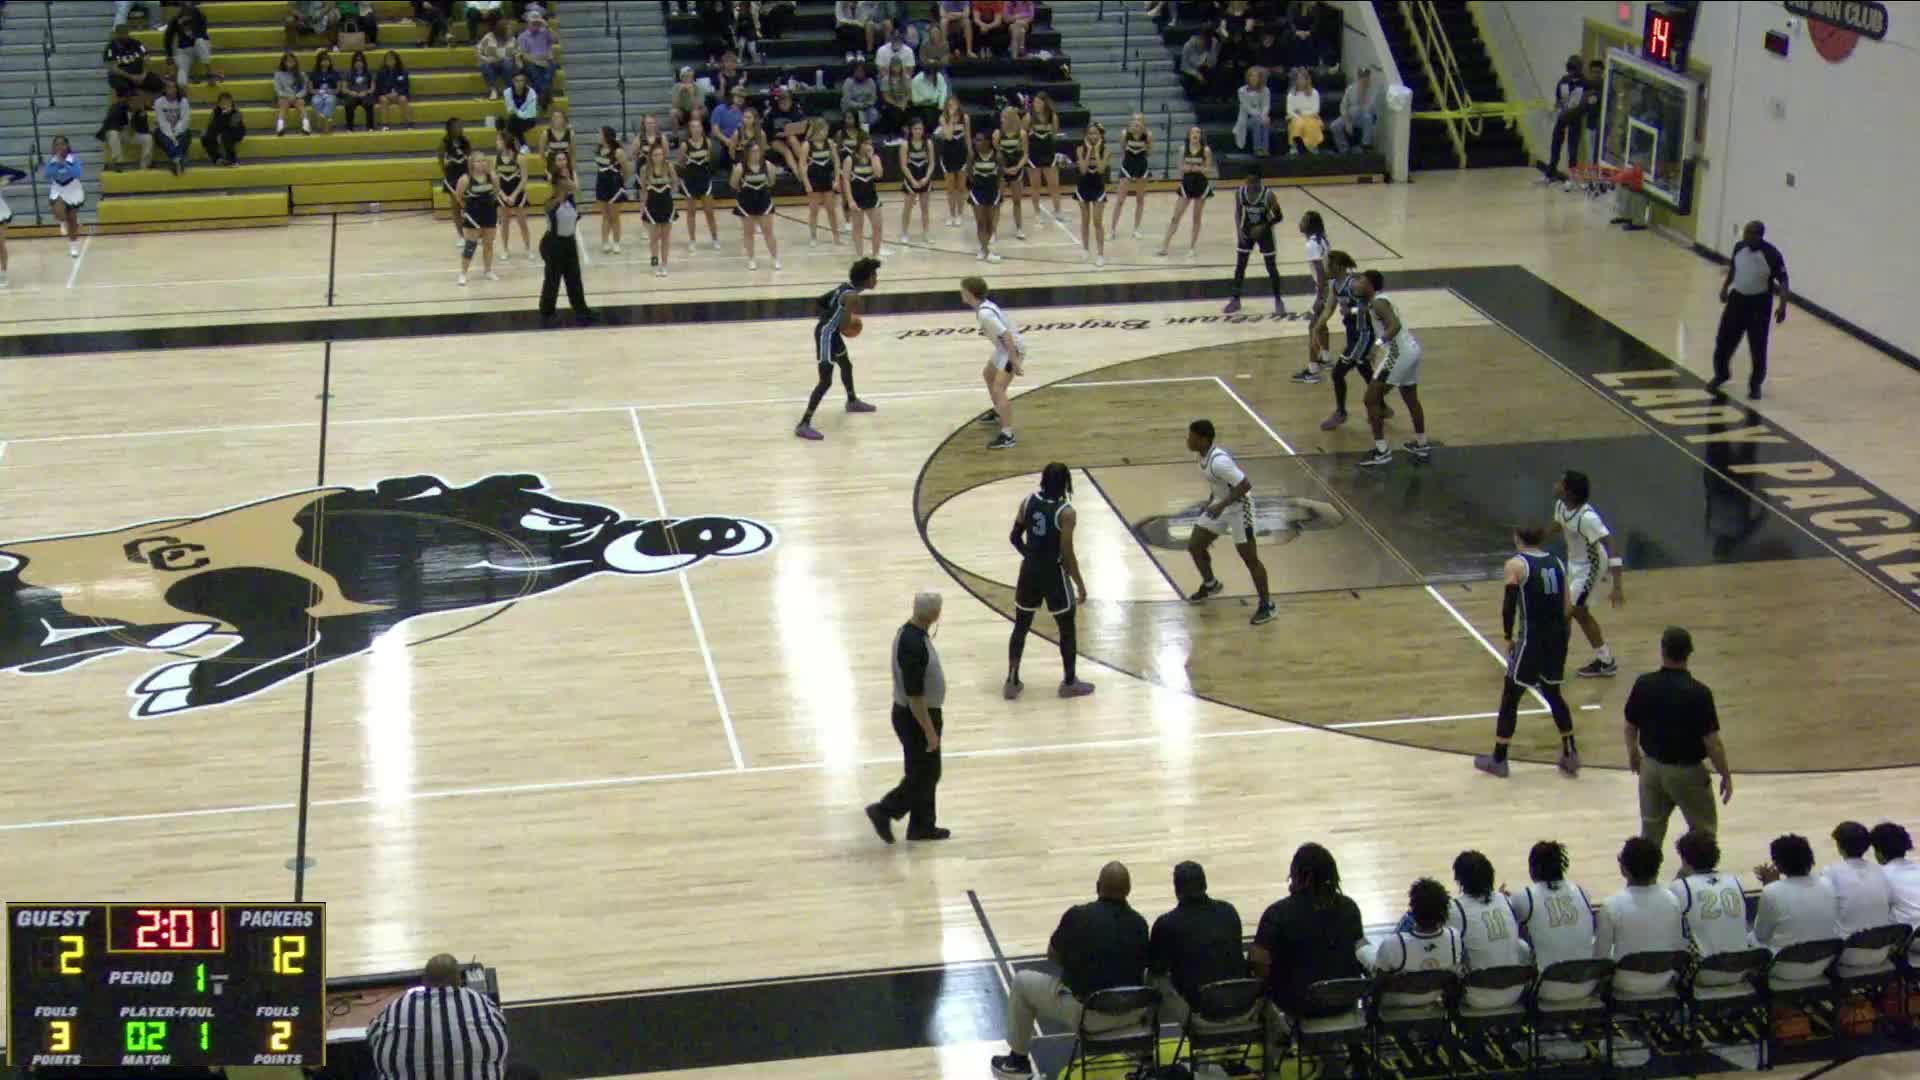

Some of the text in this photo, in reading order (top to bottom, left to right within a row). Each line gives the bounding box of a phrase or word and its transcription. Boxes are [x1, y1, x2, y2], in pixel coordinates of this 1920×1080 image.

[1652, 17, 1670, 57] 14
[898, 326, 986, 340] ourt
[1592, 369, 1790, 444] LADY
[1032, 511, 1047, 537] 3
[1540, 567, 1559, 595] 11
[1544, 895, 1579, 928] 15
[1700, 887, 1742, 919] 20
[1481, 910, 1506, 941] 11
